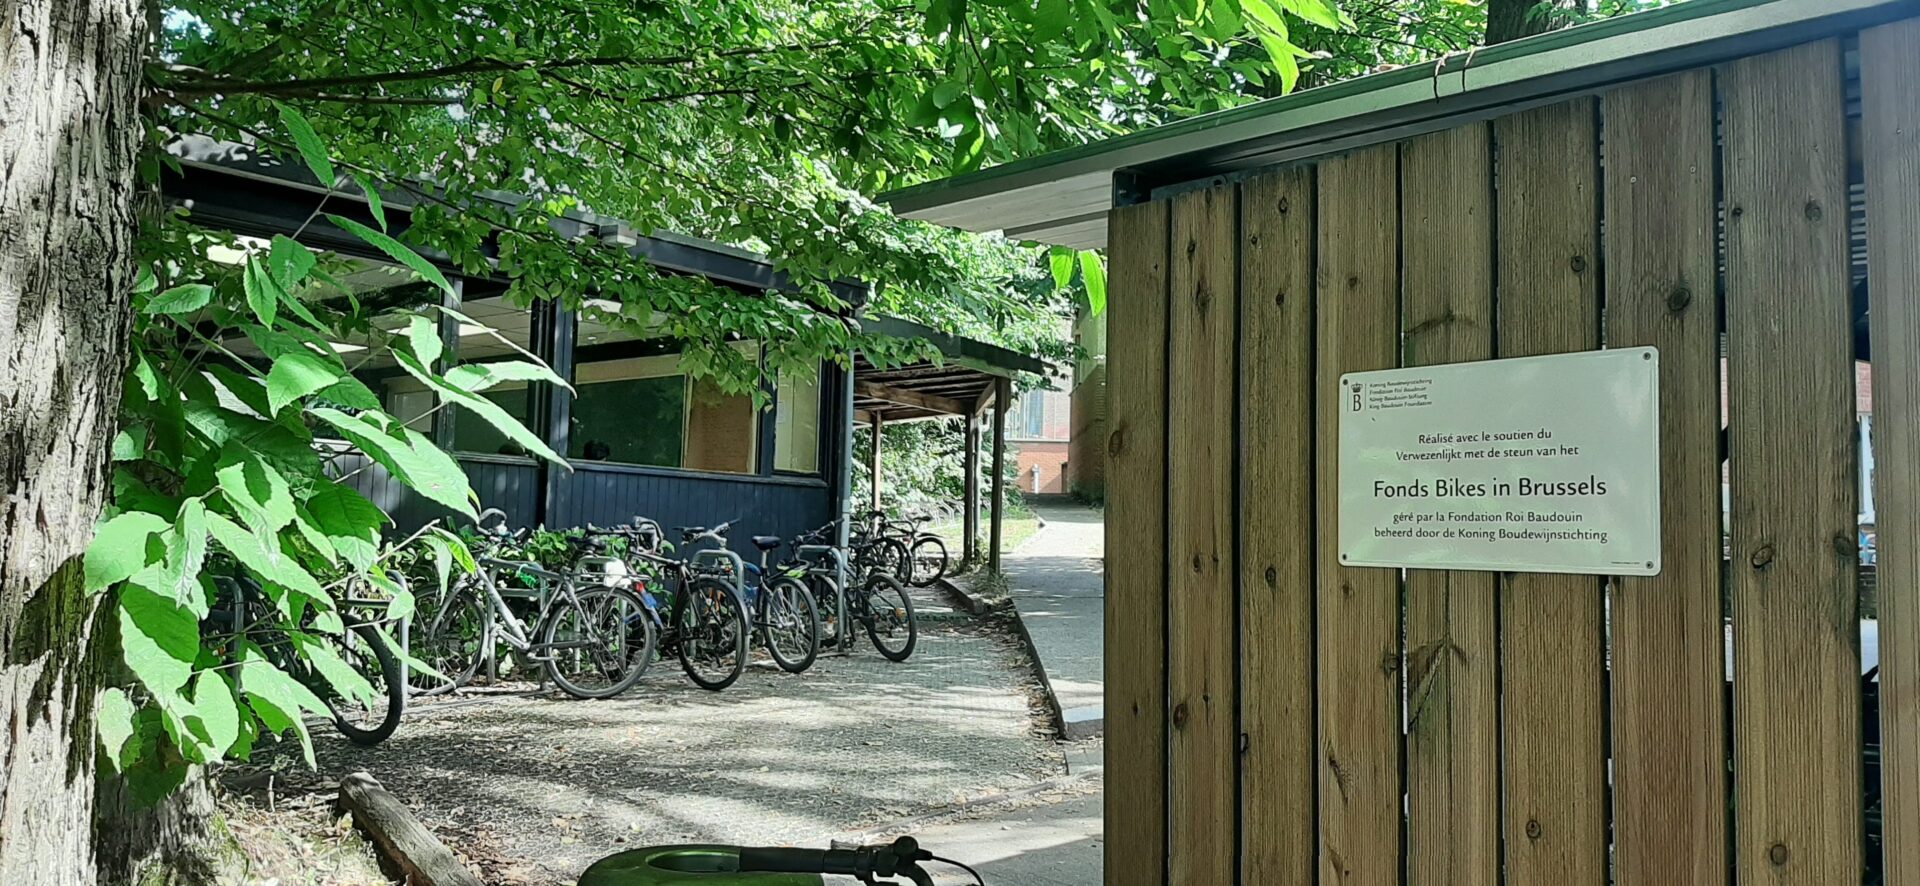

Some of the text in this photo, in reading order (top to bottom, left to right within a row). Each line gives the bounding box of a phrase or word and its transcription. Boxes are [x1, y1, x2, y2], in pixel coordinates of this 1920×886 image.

[1418, 428, 1552, 445] Réalisé avec le soutien du
[1396, 444, 1579, 462] Verwezenlijkt met de steun van het
[1374, 475, 1607, 498] Fonds Bikes in Brussels
[1393, 511, 1583, 525] géré par la Fondation Roi Baudouin
[1374, 527, 1608, 544] beheerd door de Koning Boudewijnstichting
